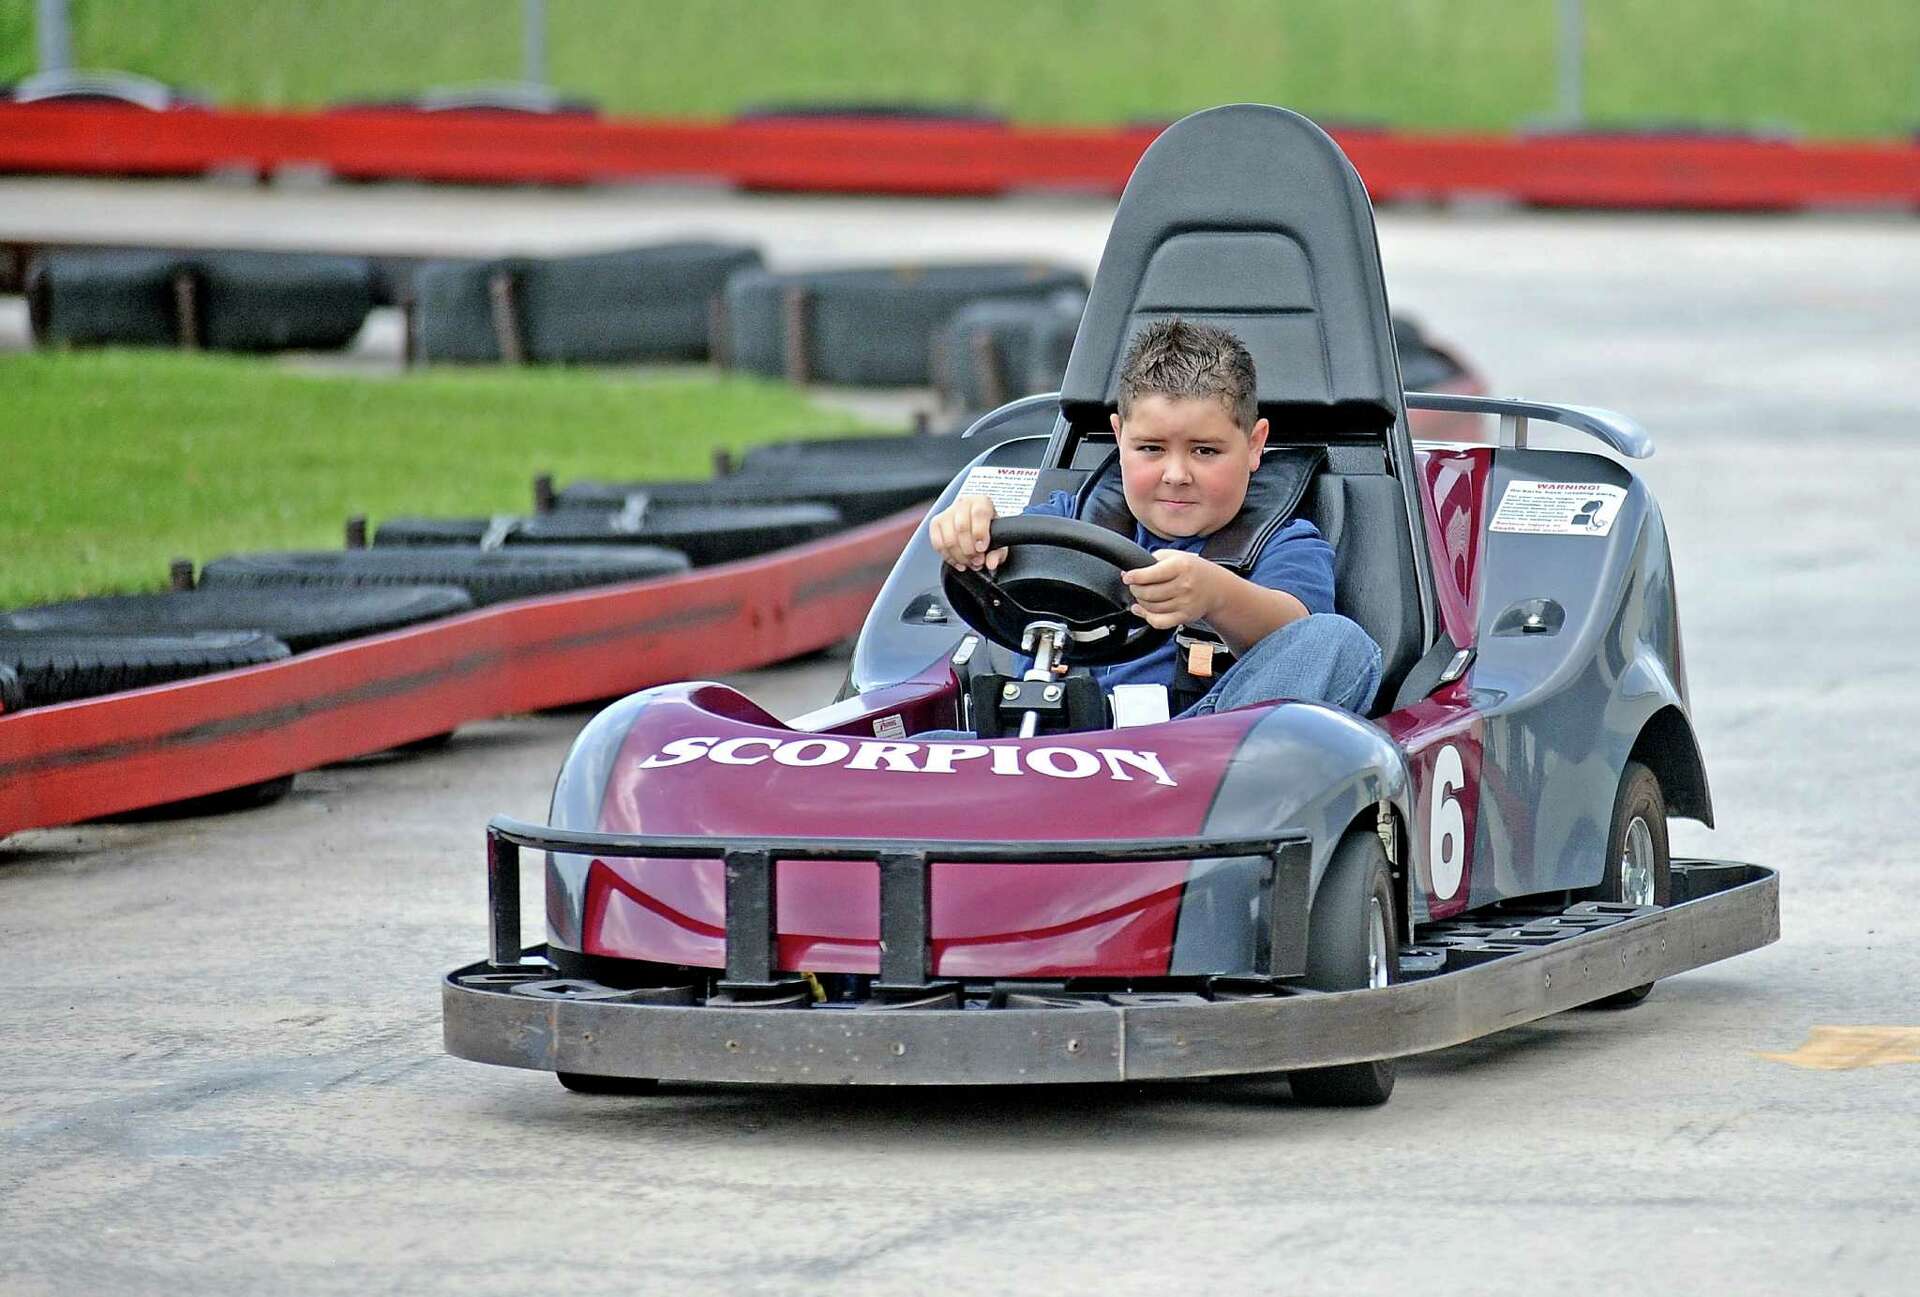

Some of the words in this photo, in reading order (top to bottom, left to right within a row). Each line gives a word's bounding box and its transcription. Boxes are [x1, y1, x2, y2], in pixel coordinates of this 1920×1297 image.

[1537, 483, 1600, 491] WARNING!
[638, 736, 1178, 787] SCORPION
[1430, 744, 1465, 900] 6
